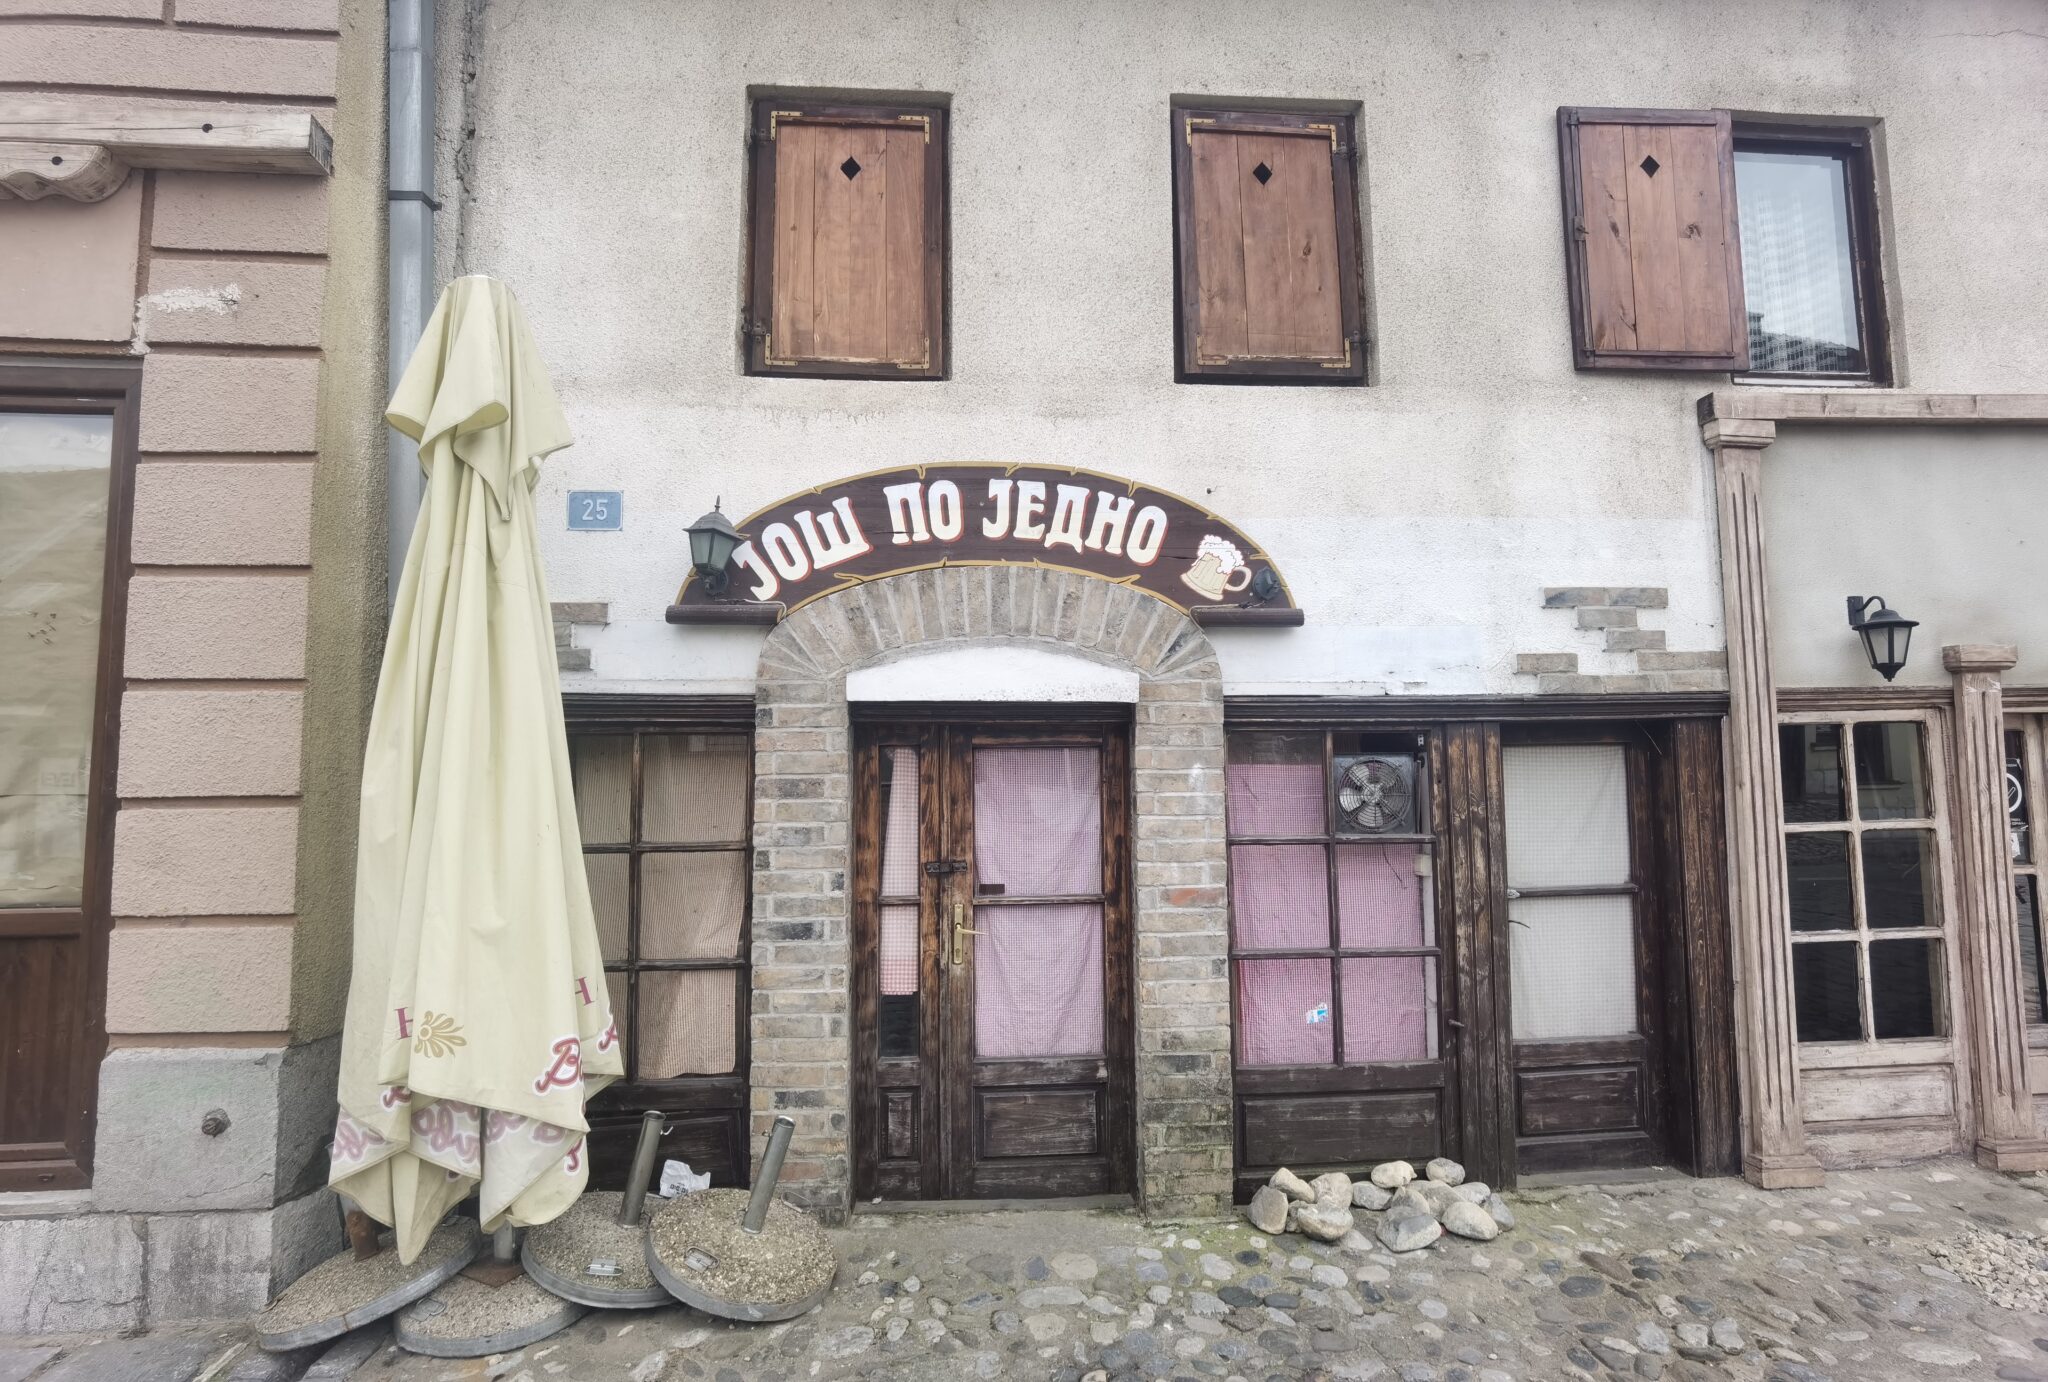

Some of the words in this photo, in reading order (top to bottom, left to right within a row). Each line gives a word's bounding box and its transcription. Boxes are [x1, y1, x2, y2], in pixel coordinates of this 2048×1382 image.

[582, 499, 609, 521] 25
[731, 496, 873, 601] ЈОШ
[883, 479, 964, 544] ПО
[982, 478, 1169, 566] ЈЕДНО
